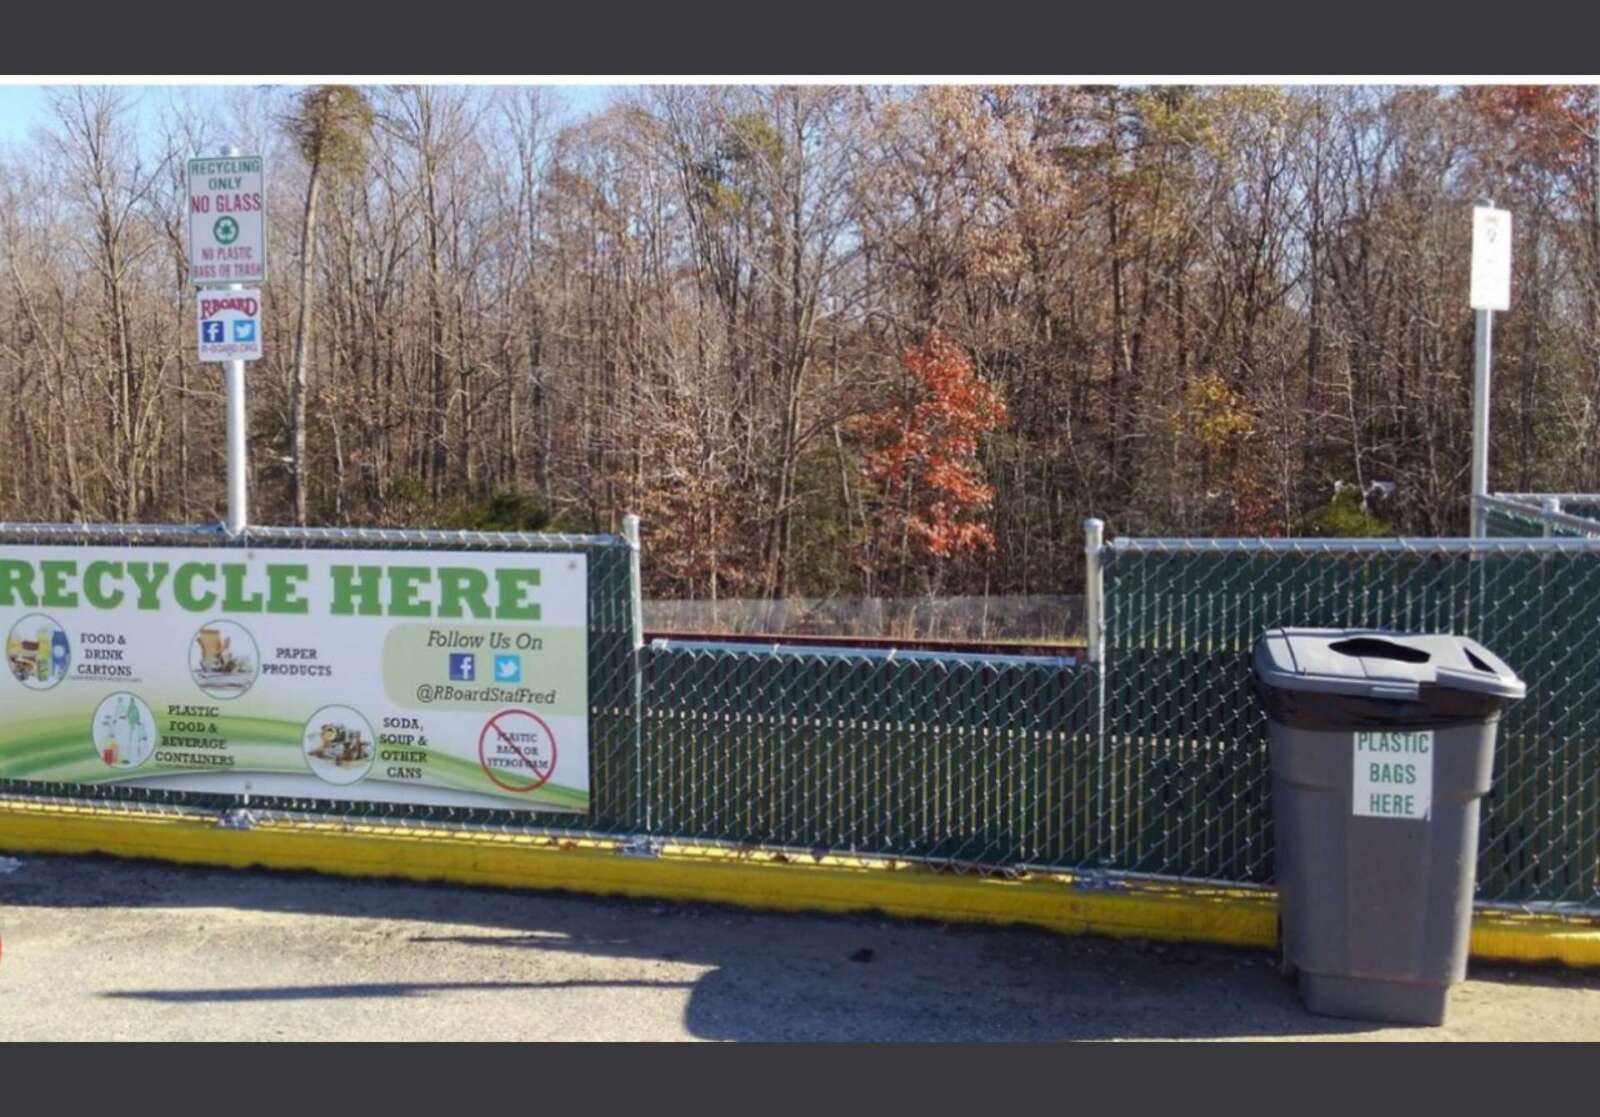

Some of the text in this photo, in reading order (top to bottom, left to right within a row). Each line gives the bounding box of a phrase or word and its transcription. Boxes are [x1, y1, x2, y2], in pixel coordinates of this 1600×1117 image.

[191, 160, 260, 175] RECYCLING
[208, 177, 242, 190] ONLY
[191, 193, 261, 213] NO GLASS
[202, 247, 252, 260] NO PLASTIC
[193, 263, 262, 278] BAGS OR TRASH
[0, 559, 541, 620] RECYCLE HERE
[80, 633, 126, 645] FOOD &
[427, 630, 543, 650] Follow Us On
[84, 648, 124, 660] DRINK
[276, 648, 317, 659] PAPER
[77, 664, 132, 676] CARTONS
[262, 664, 332, 676] PRODUCTS
[168, 705, 219, 717] PLASTIC
[169, 721, 218, 733] FOOD &
[383, 716, 424, 732] SODA,
[161, 736, 227, 749] BEVERAGE
[380, 734, 427, 746] SOUP &
[1358, 731, 1429, 754] PLASTIC
[155, 752, 235, 766] CONTAINERS
[381, 751, 428, 763] OTHER
[387, 767, 422, 778] CANS
[1370, 762, 1416, 784] BAGS
[1369, 793, 1414, 815] HERE
